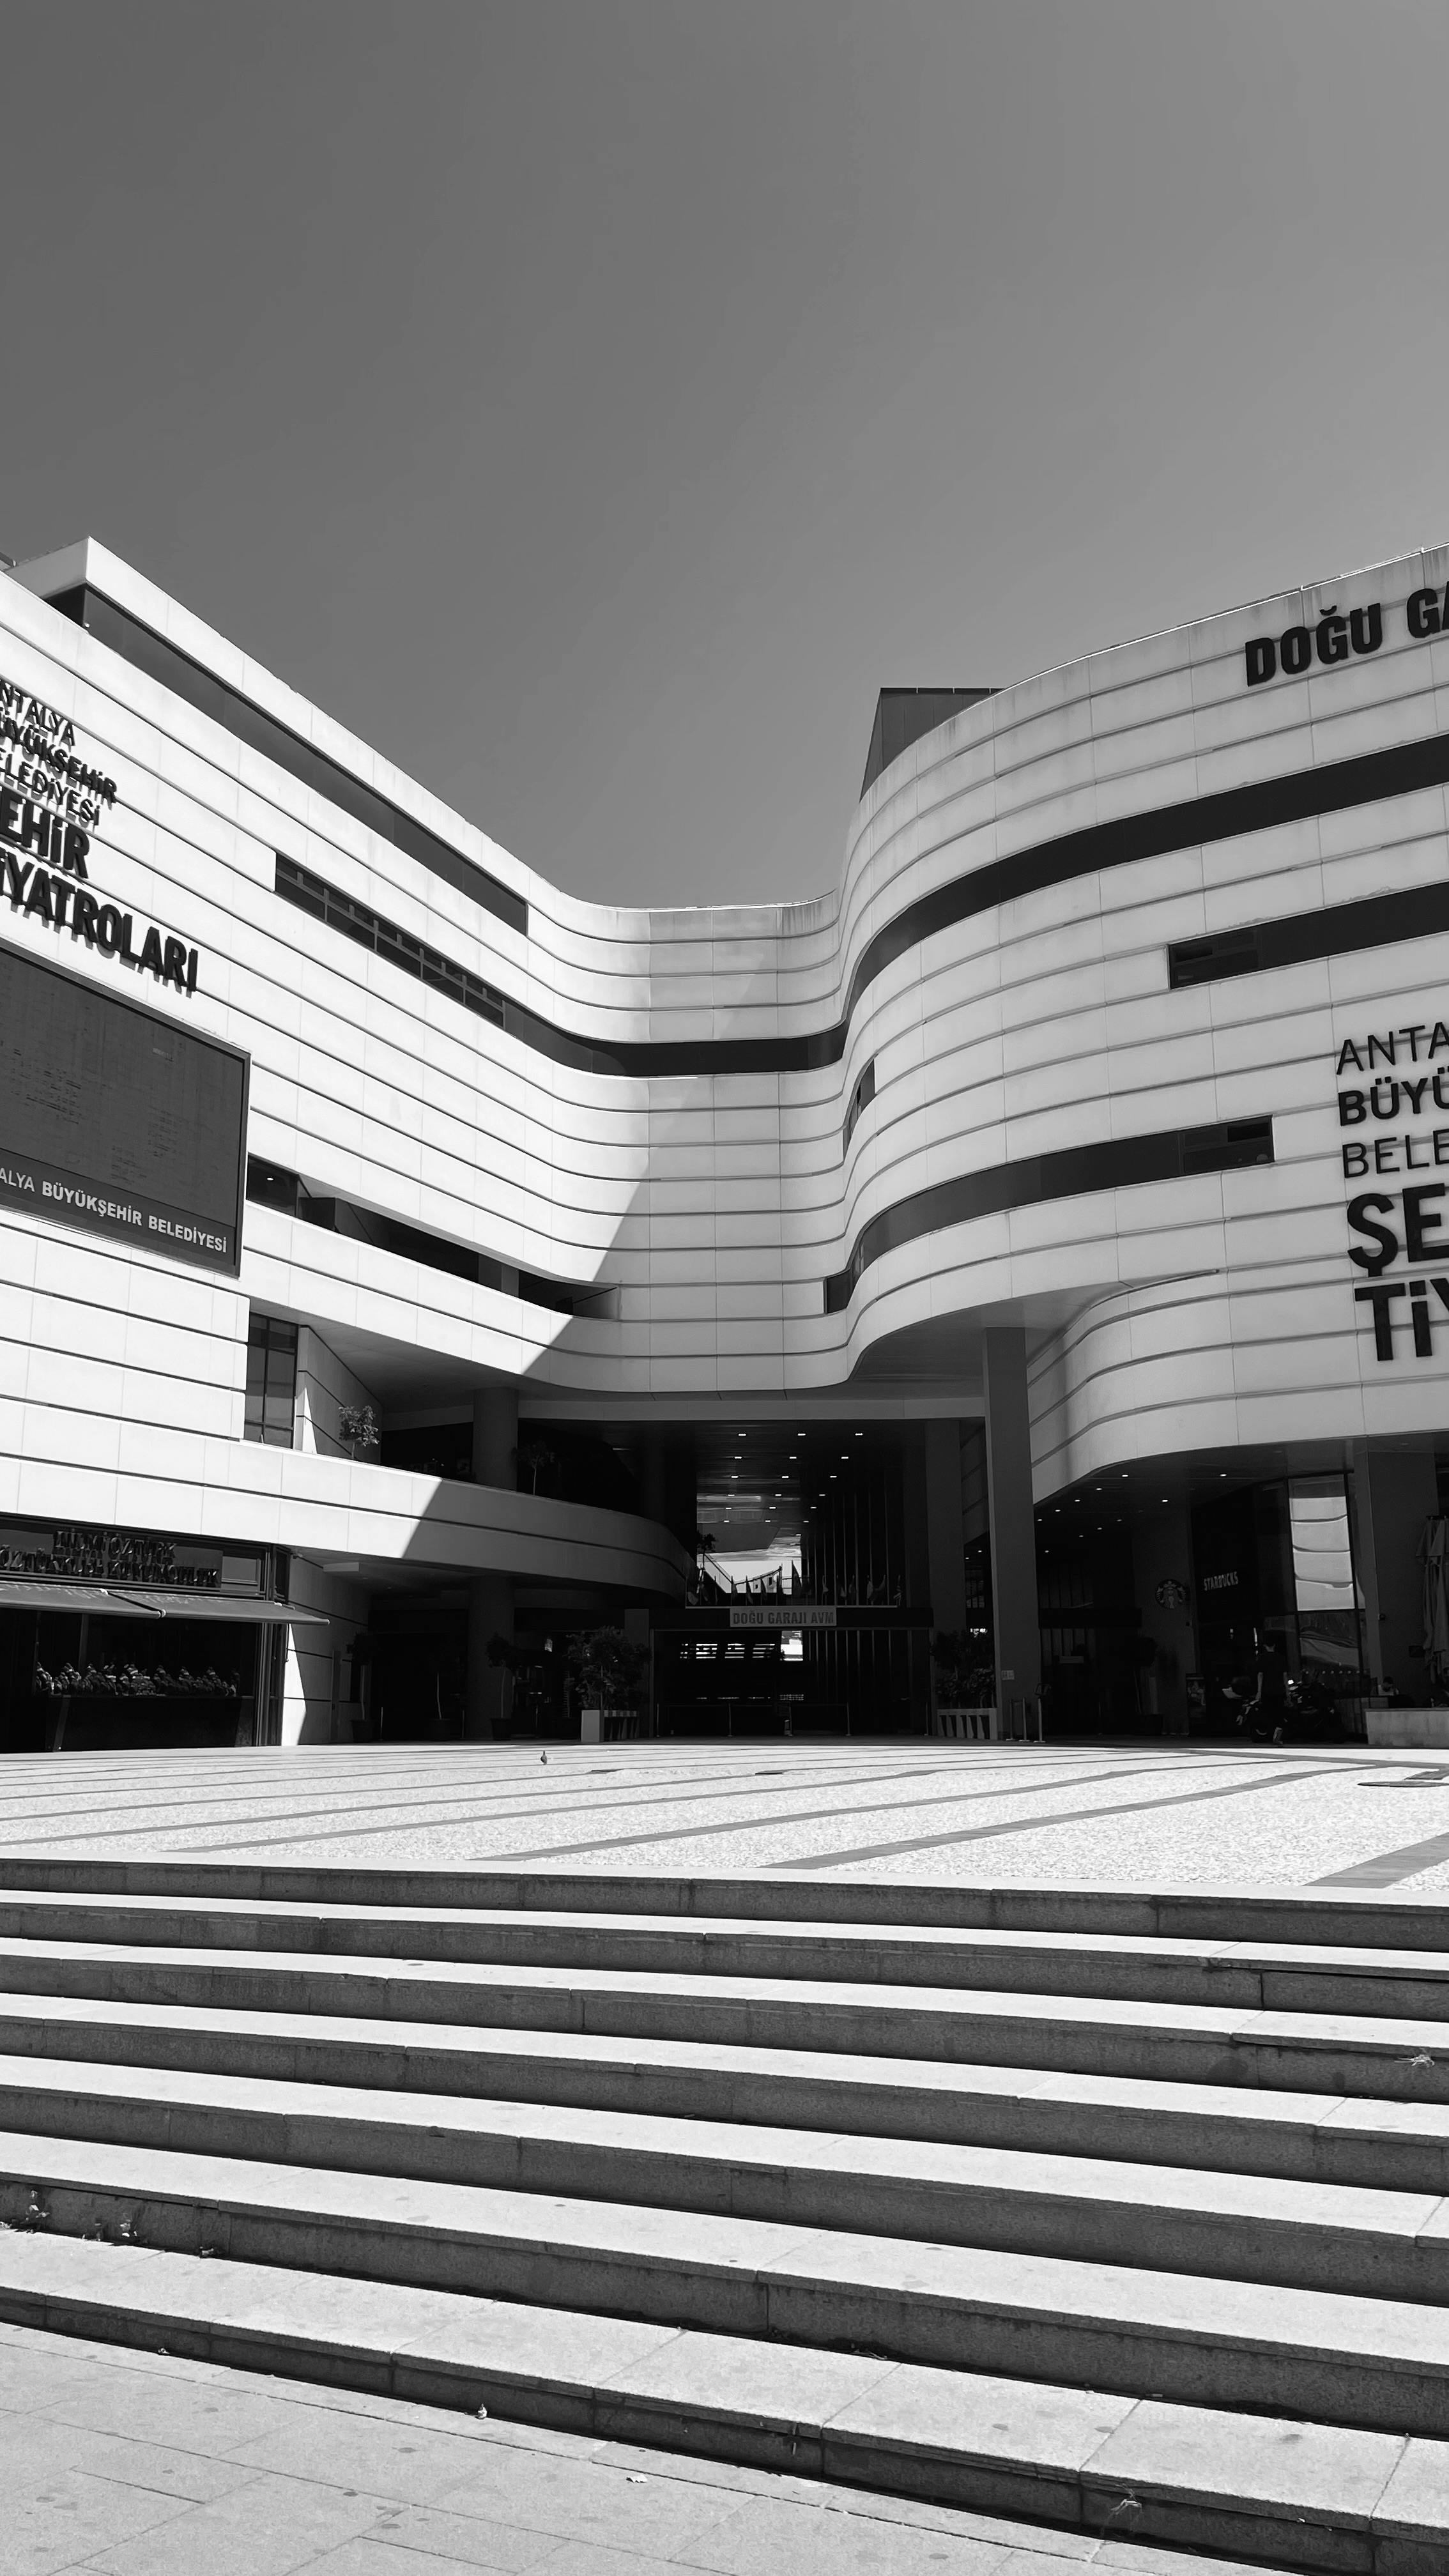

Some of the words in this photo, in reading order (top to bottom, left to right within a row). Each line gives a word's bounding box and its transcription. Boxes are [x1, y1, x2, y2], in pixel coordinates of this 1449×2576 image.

[1245, 603, 1383, 687] DOĞU
[1407, 581, 1449, 638] G
[42, 1181, 142, 1226] BÜYÜKŞEHİR
[148, 1215, 227, 1253] BELEDİYESİ
[1347, 1183, 1449, 1278] ŞE
[1203, 1571, 1239, 1591] STARBUCKS
[733, 1610, 764, 1625] DOĞU
[768, 1612, 807, 1624] GARAJI
[811, 1611, 834, 1624] AVM
